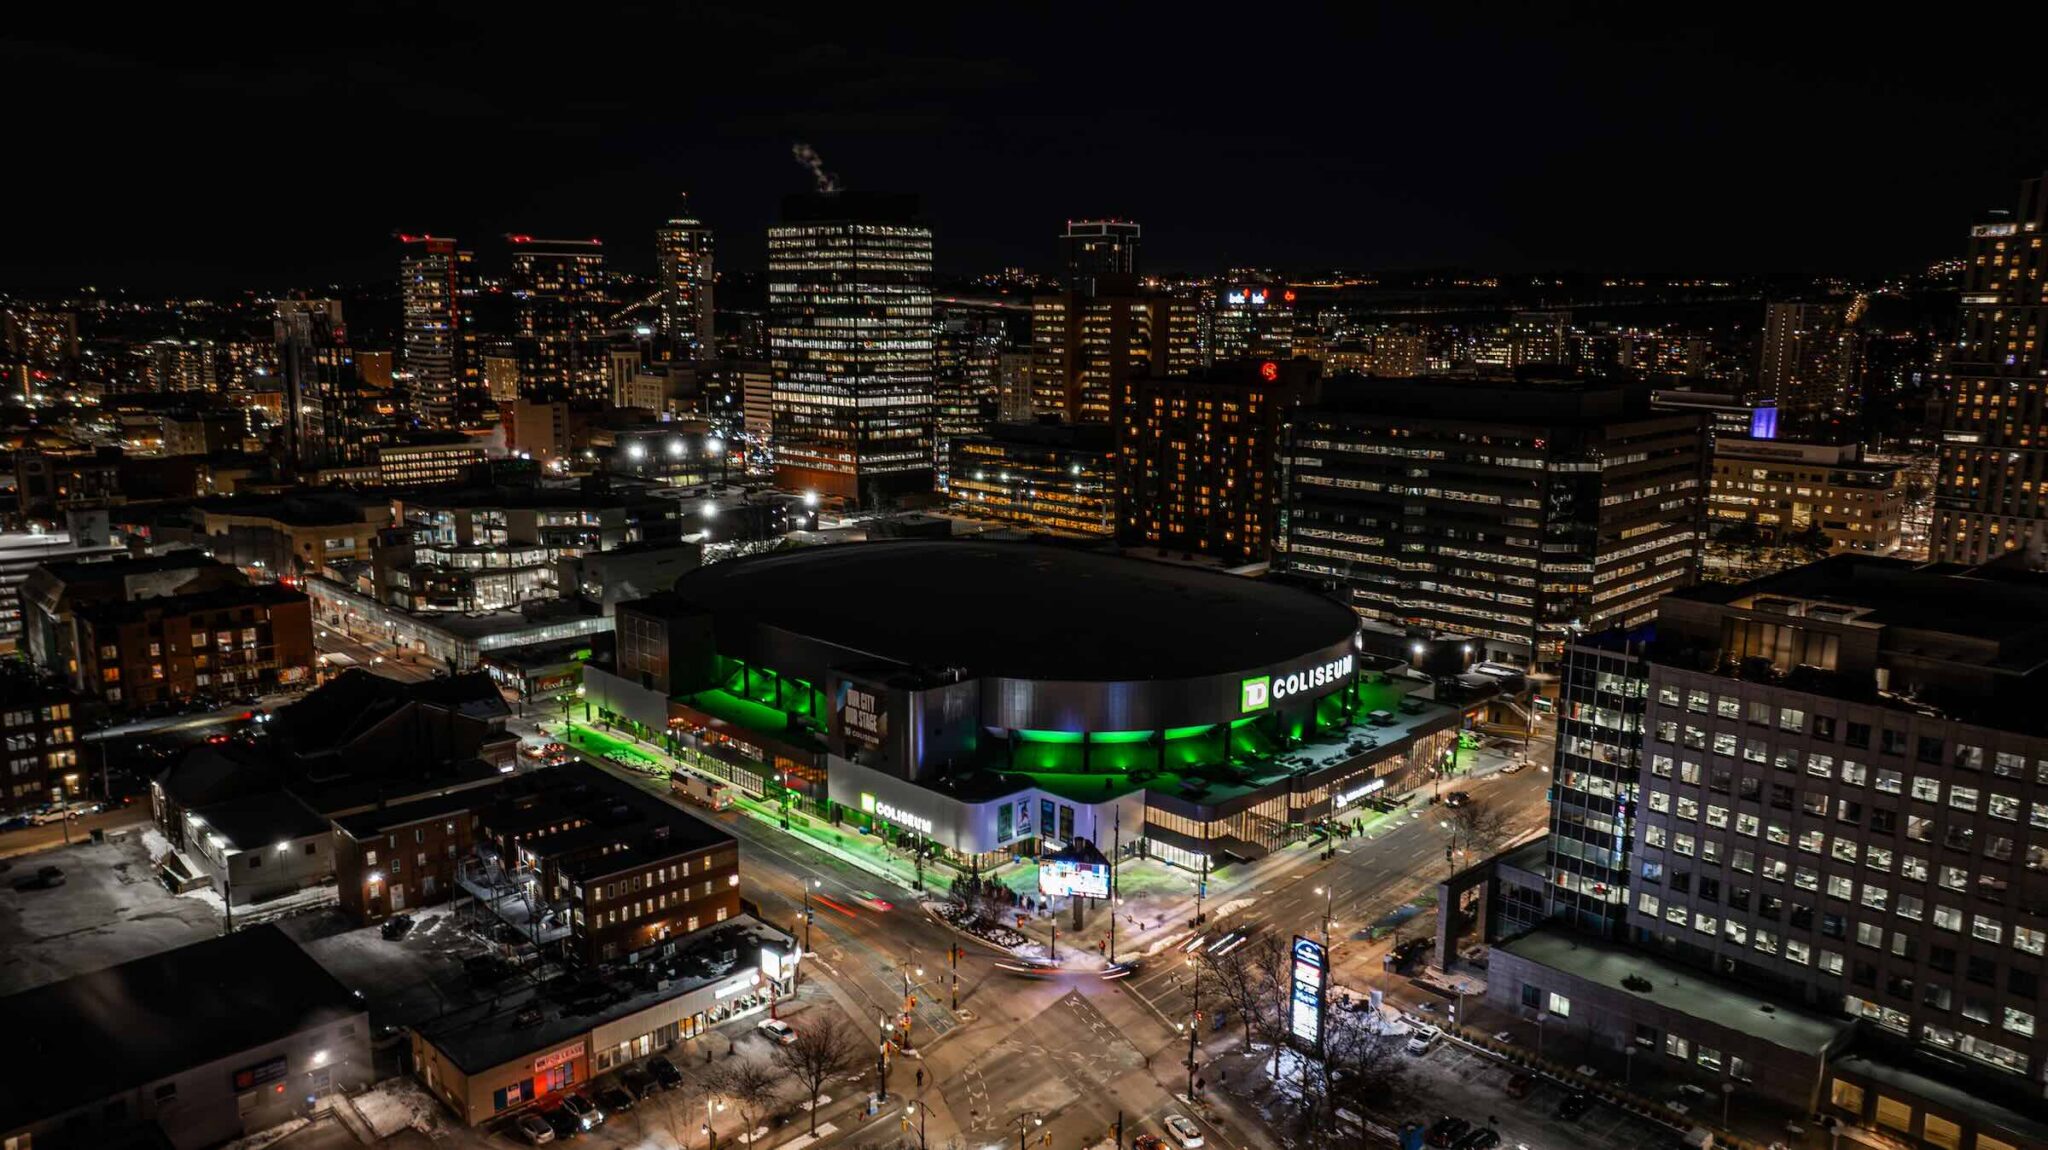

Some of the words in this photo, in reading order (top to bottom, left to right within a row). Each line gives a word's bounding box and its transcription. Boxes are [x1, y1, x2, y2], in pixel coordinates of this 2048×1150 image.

[1245, 682, 1267, 706] TD
[1273, 655, 1352, 699] COLISEUM
[860, 692, 875, 713] CITY
[858, 710, 878, 733] STAGE
[876, 801, 932, 834] COLISEUM
[561, 1046, 582, 1058] LEASE
